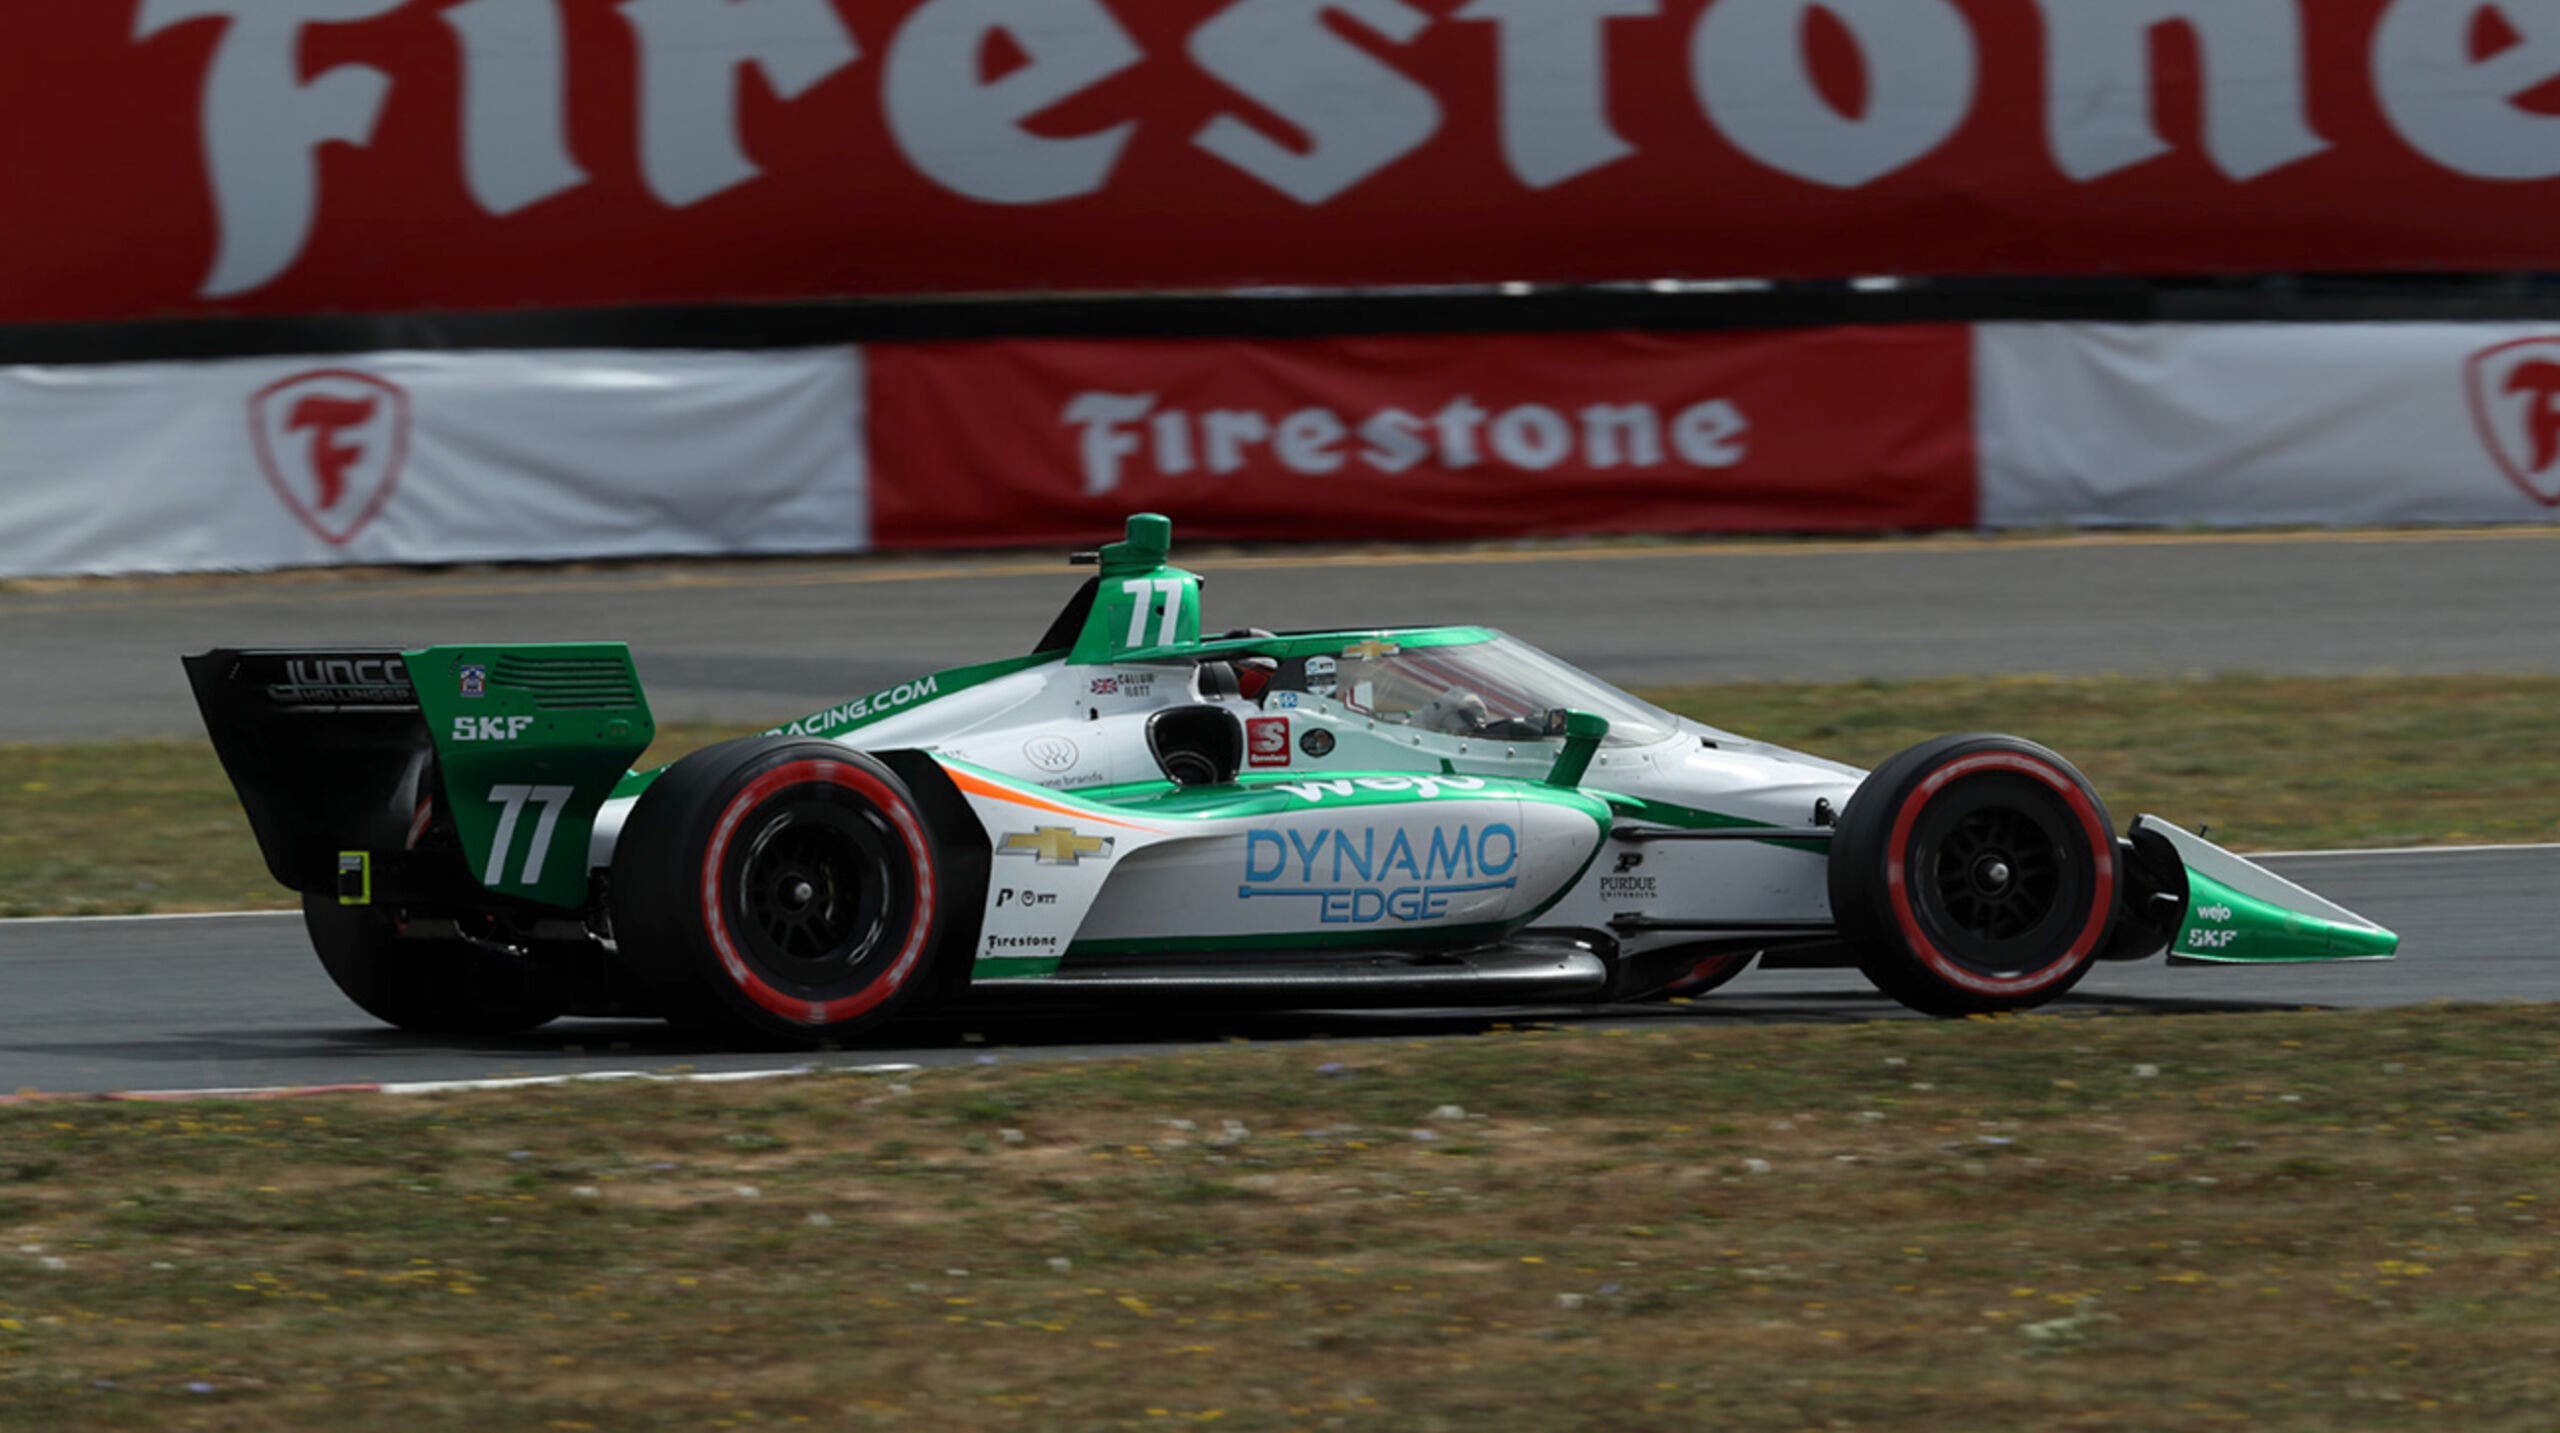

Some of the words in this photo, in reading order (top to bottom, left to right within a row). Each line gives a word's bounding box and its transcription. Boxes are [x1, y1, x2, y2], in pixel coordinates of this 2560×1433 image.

[131, 0, 2560, 297] Firestone
[1060, 391, 1748, 498] Firestone
[1122, 578, 1184, 649] 77
[451, 715, 535, 741] SKF
[483, 783, 575, 886] 77
[1244, 822, 1518, 883] DYNAMO
[1600, 876, 1657, 891] PURDUE
[1320, 886, 1448, 924] EDGE
[2196, 903, 2232, 923] wejo
[987, 934, 1057, 950] Firestone
[2188, 928, 2239, 947] SKF
